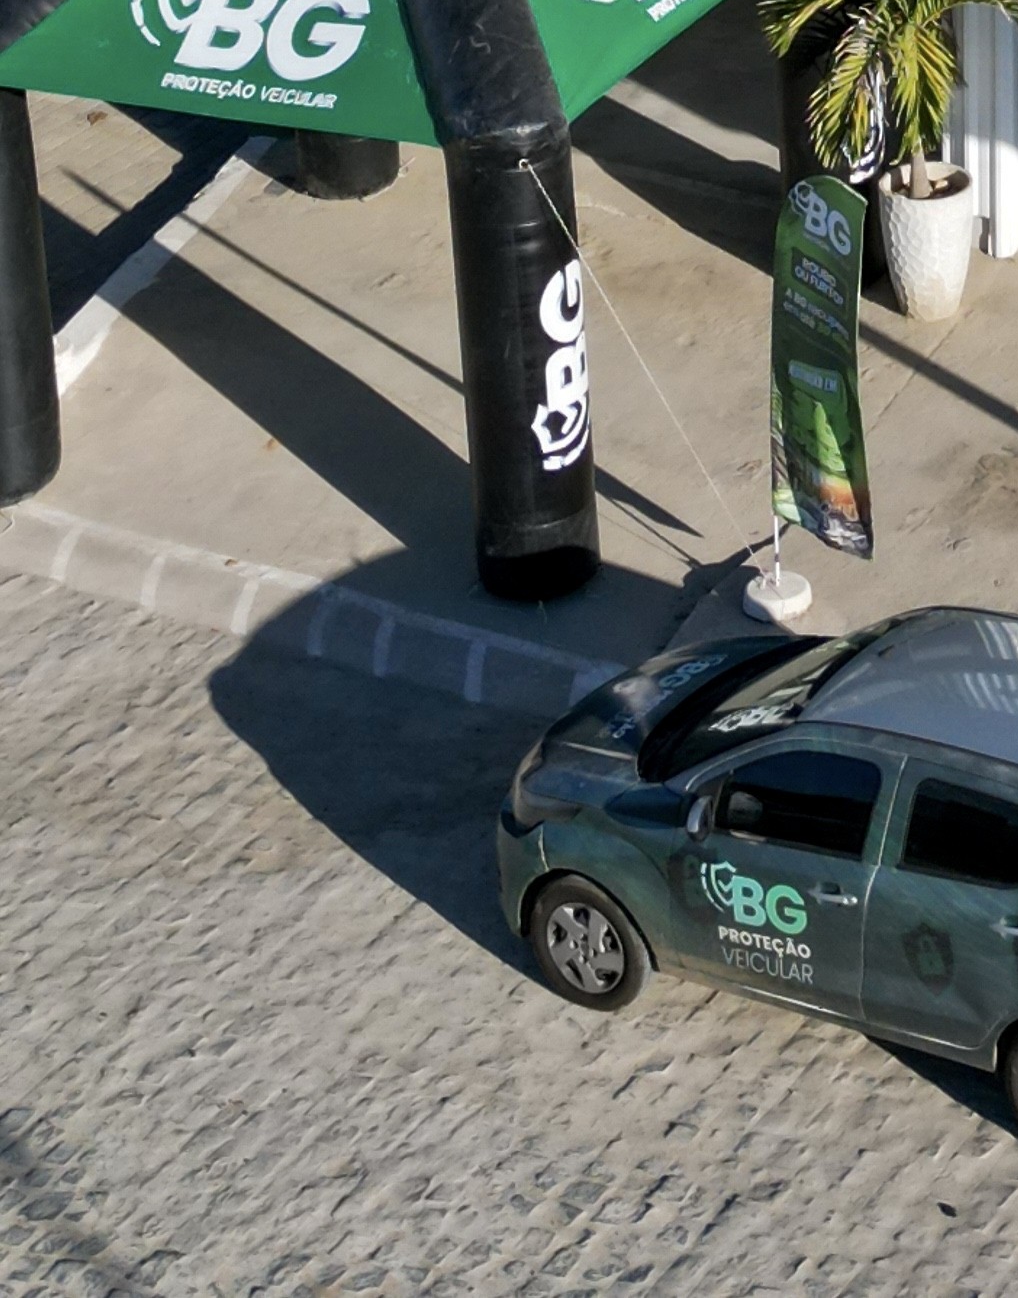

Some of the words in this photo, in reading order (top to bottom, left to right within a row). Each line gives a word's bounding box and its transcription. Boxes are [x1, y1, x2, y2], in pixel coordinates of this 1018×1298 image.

[160, 72, 256, 99] PROTEÇÃO
[260, 85, 338, 109] VEICULAR
[804, 190, 851, 256] BG
[539, 258, 590, 412] BG
[732, 874, 808, 935] BG
[717, 925, 811, 959] PROTEÇÃO
[721, 945, 813, 984] VEICULAR
